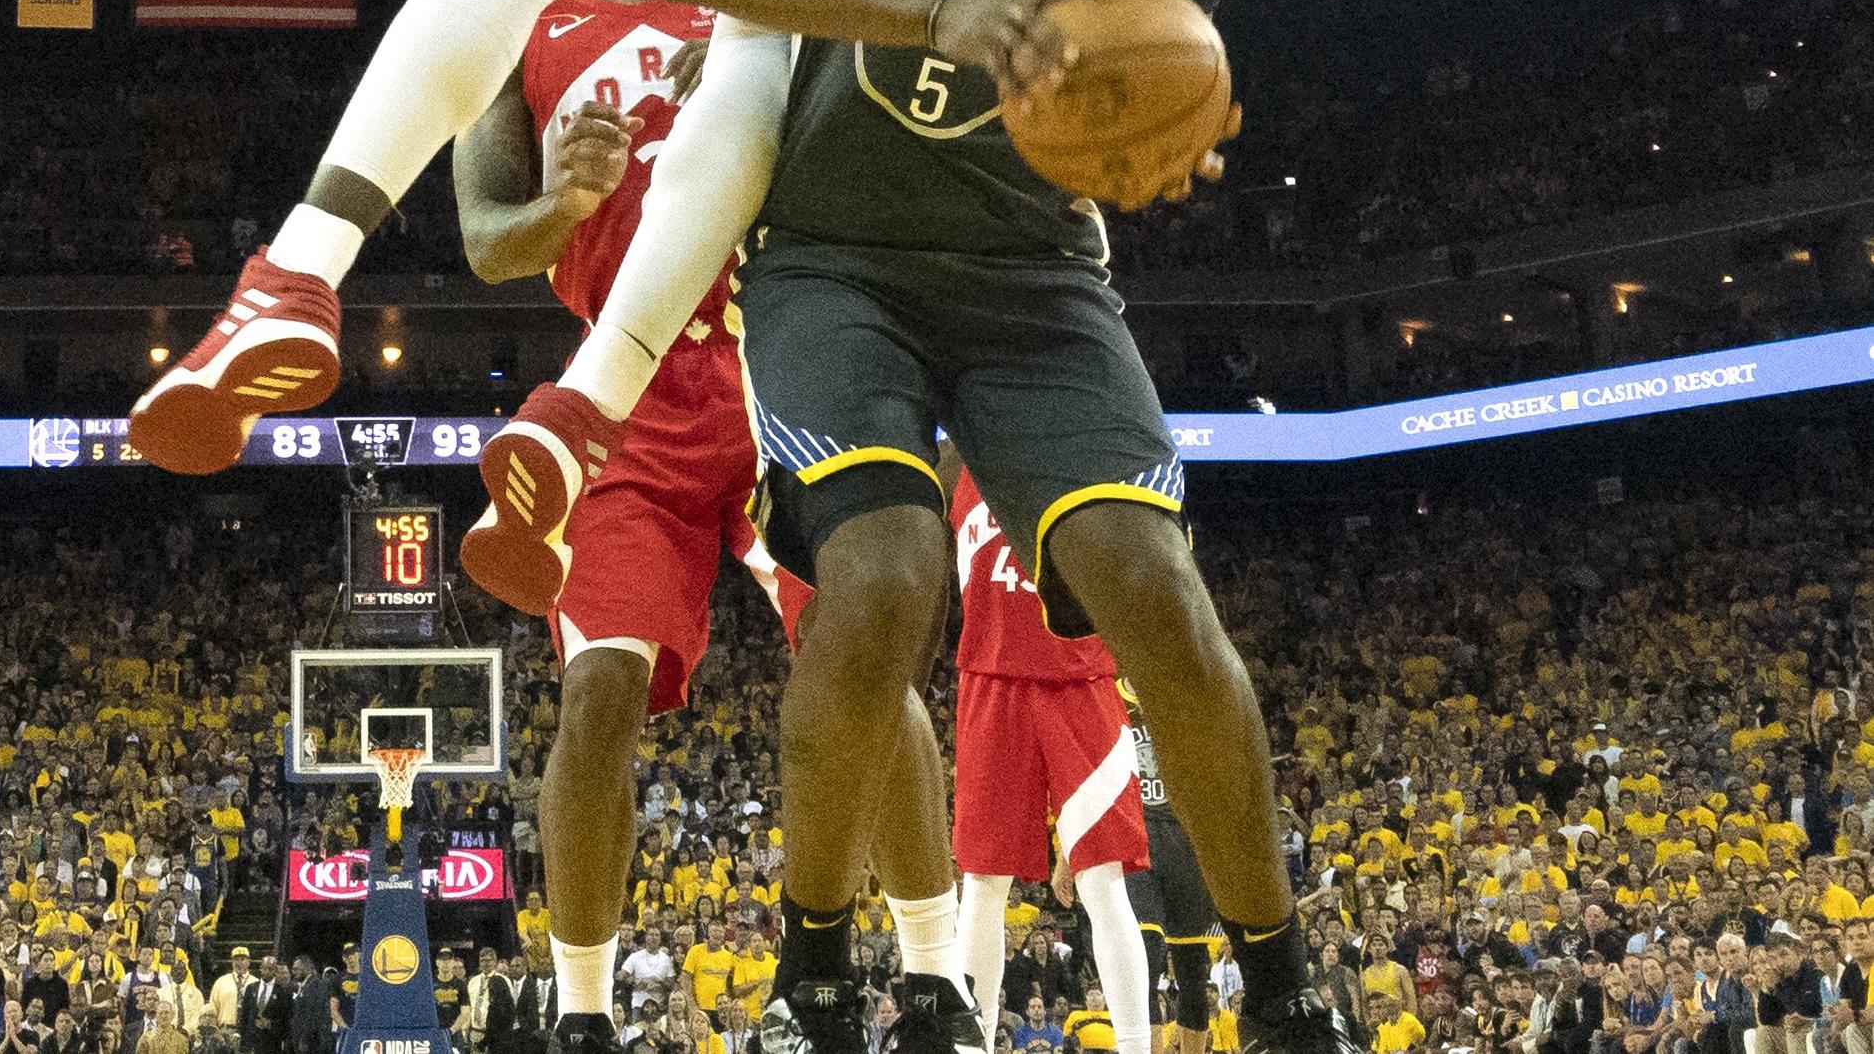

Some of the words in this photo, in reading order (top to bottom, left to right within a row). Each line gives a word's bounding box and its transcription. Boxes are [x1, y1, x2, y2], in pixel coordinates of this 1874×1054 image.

[910, 58, 955, 122] 5
[1400, 408, 1476, 436] CACHE
[1480, 395, 1557, 424] CREEK
[1582, 379, 1669, 408] CASINO
[1672, 363, 1757, 395] RESORT
[273, 425, 321, 458] 83
[351, 423, 400, 444] 4:55
[432, 424, 481, 457] 93
[1171, 427, 1214, 447] ORT
[92, 443, 105, 461] 5
[376, 515, 429, 541] 4:55
[385, 543, 422, 584] 10
[377, 592, 436, 604] TISSOT
[1140, 779, 1165, 800] 30
[376, 880, 413, 890] SPALDING
